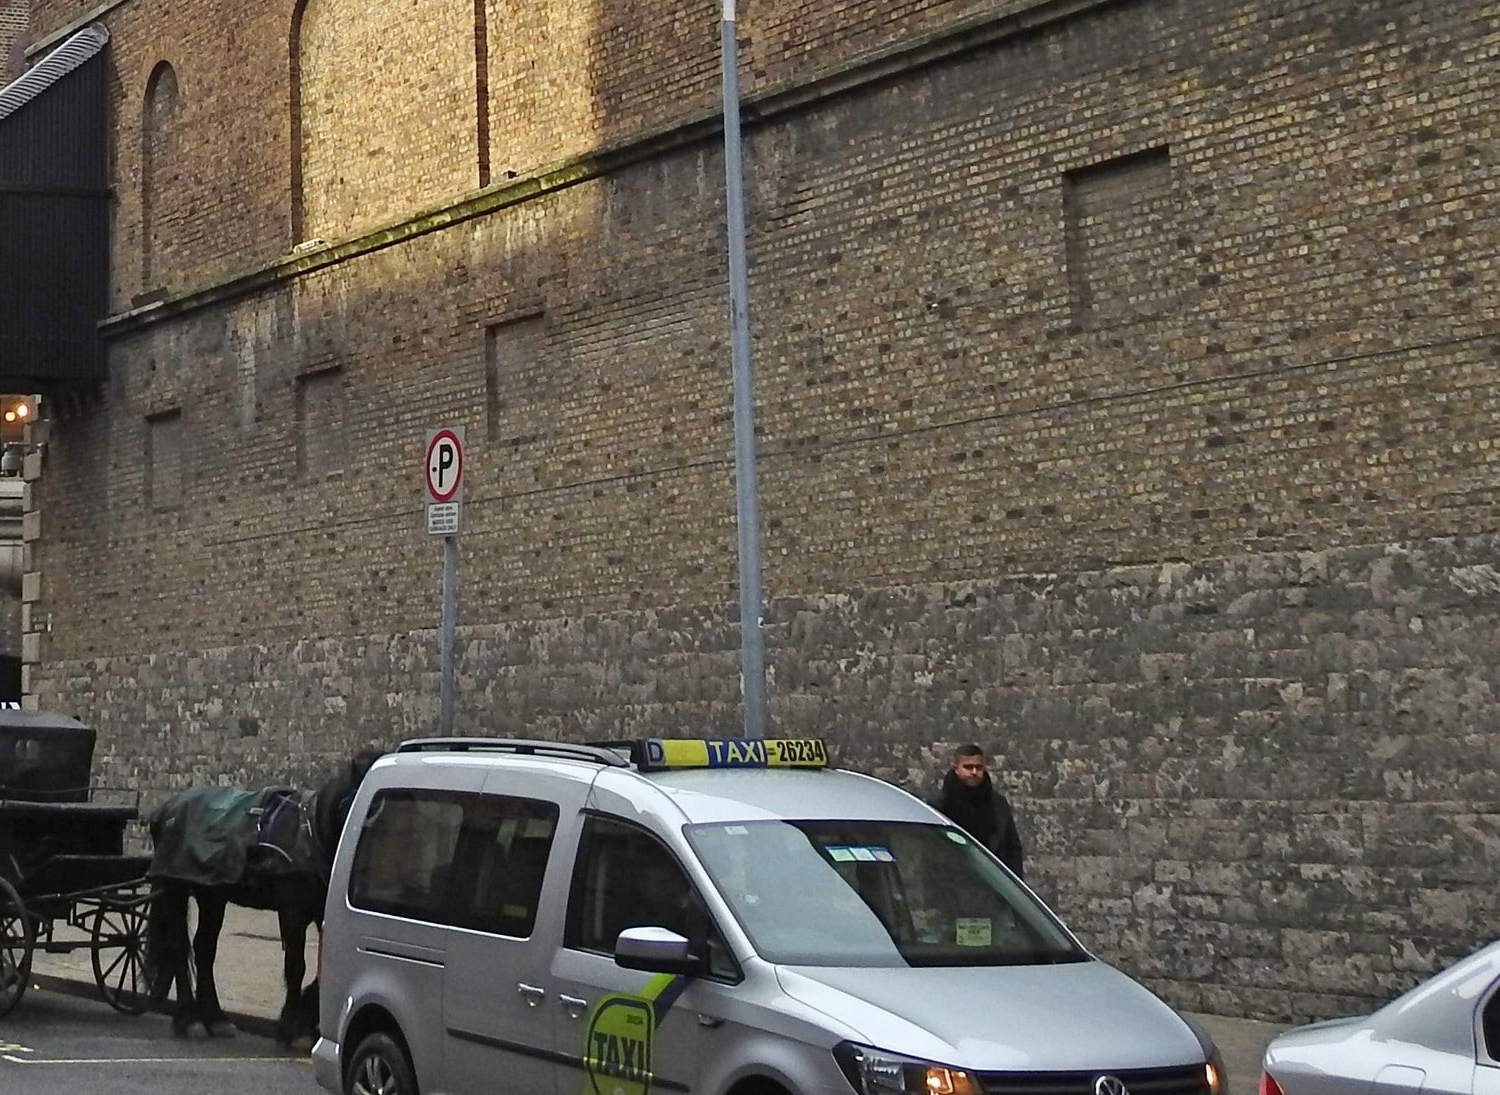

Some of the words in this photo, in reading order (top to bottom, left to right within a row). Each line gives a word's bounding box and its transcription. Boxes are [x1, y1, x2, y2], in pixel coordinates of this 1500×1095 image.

[439, 444, 453, 487] P
[708, 741, 767, 764] TAXI
[776, 741, 824, 762] 26234
[593, 1030, 645, 1083] TAXI
